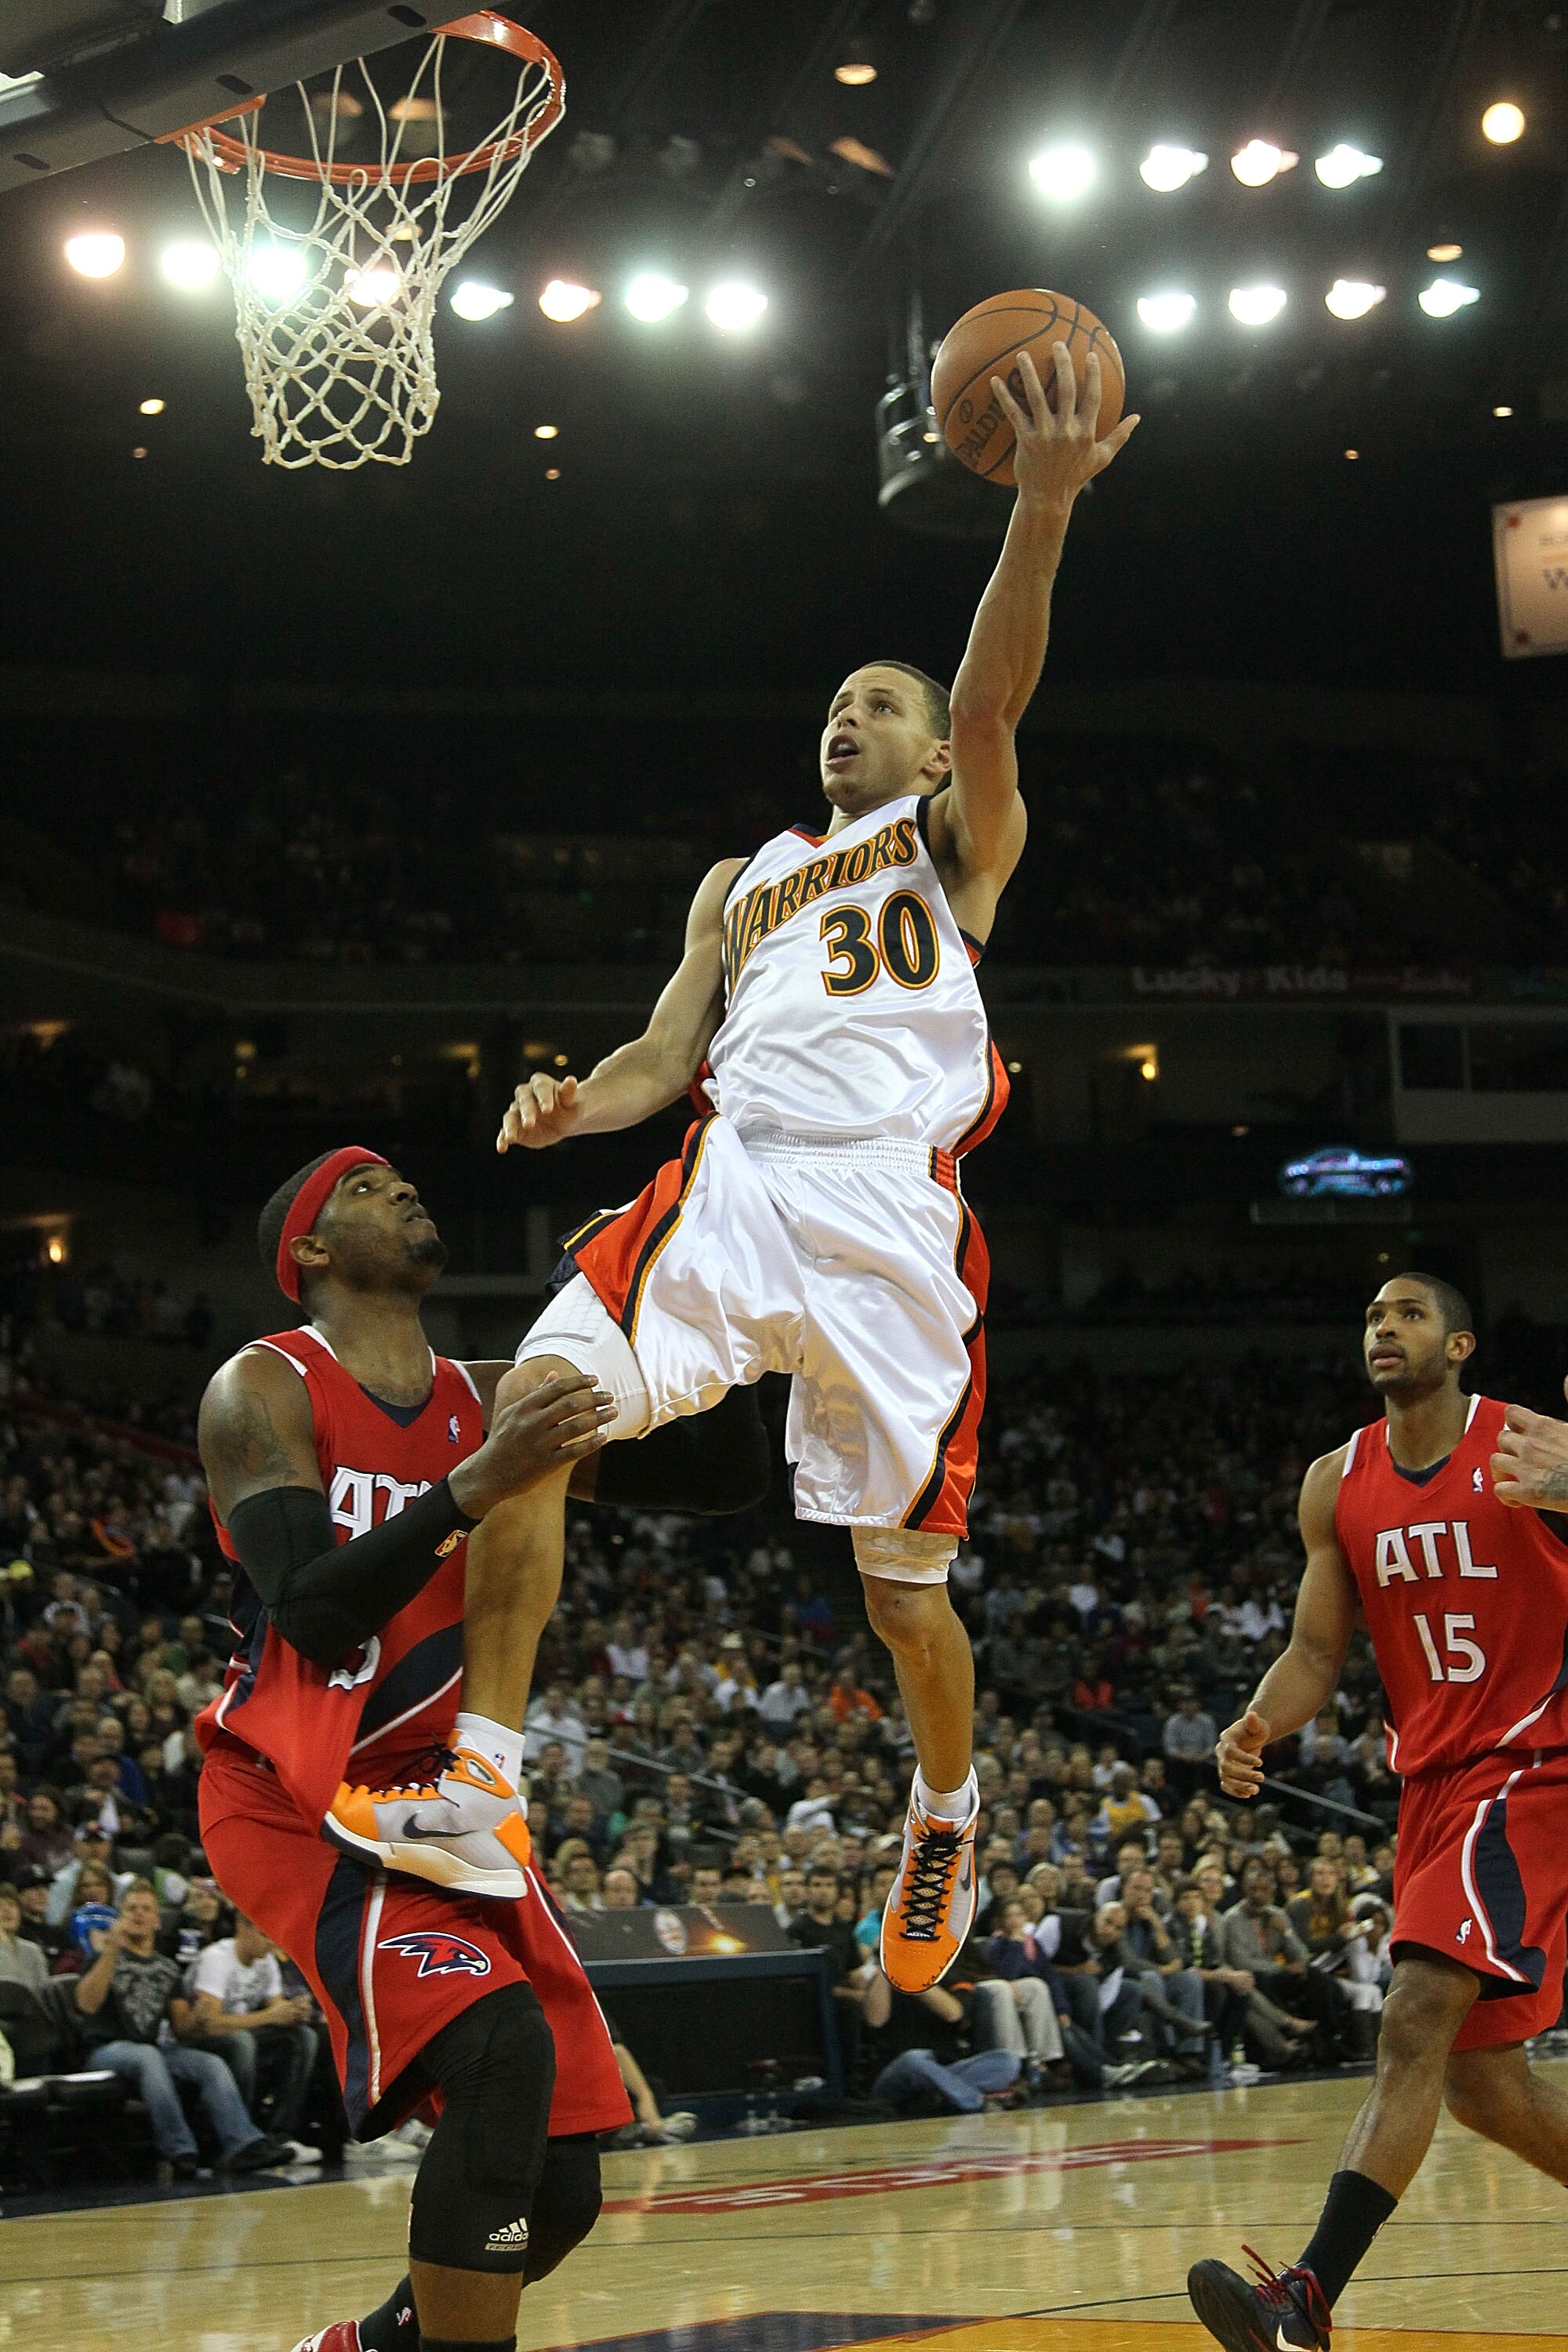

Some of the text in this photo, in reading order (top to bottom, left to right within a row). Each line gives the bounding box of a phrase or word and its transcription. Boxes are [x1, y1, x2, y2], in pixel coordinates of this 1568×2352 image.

[723, 817, 918, 1010] WARRIORS
[819, 888, 941, 996] 30
[329, 1465, 433, 1542] AT
[1375, 1519, 1499, 1588] ATL
[1413, 1612, 1487, 1683] 15
